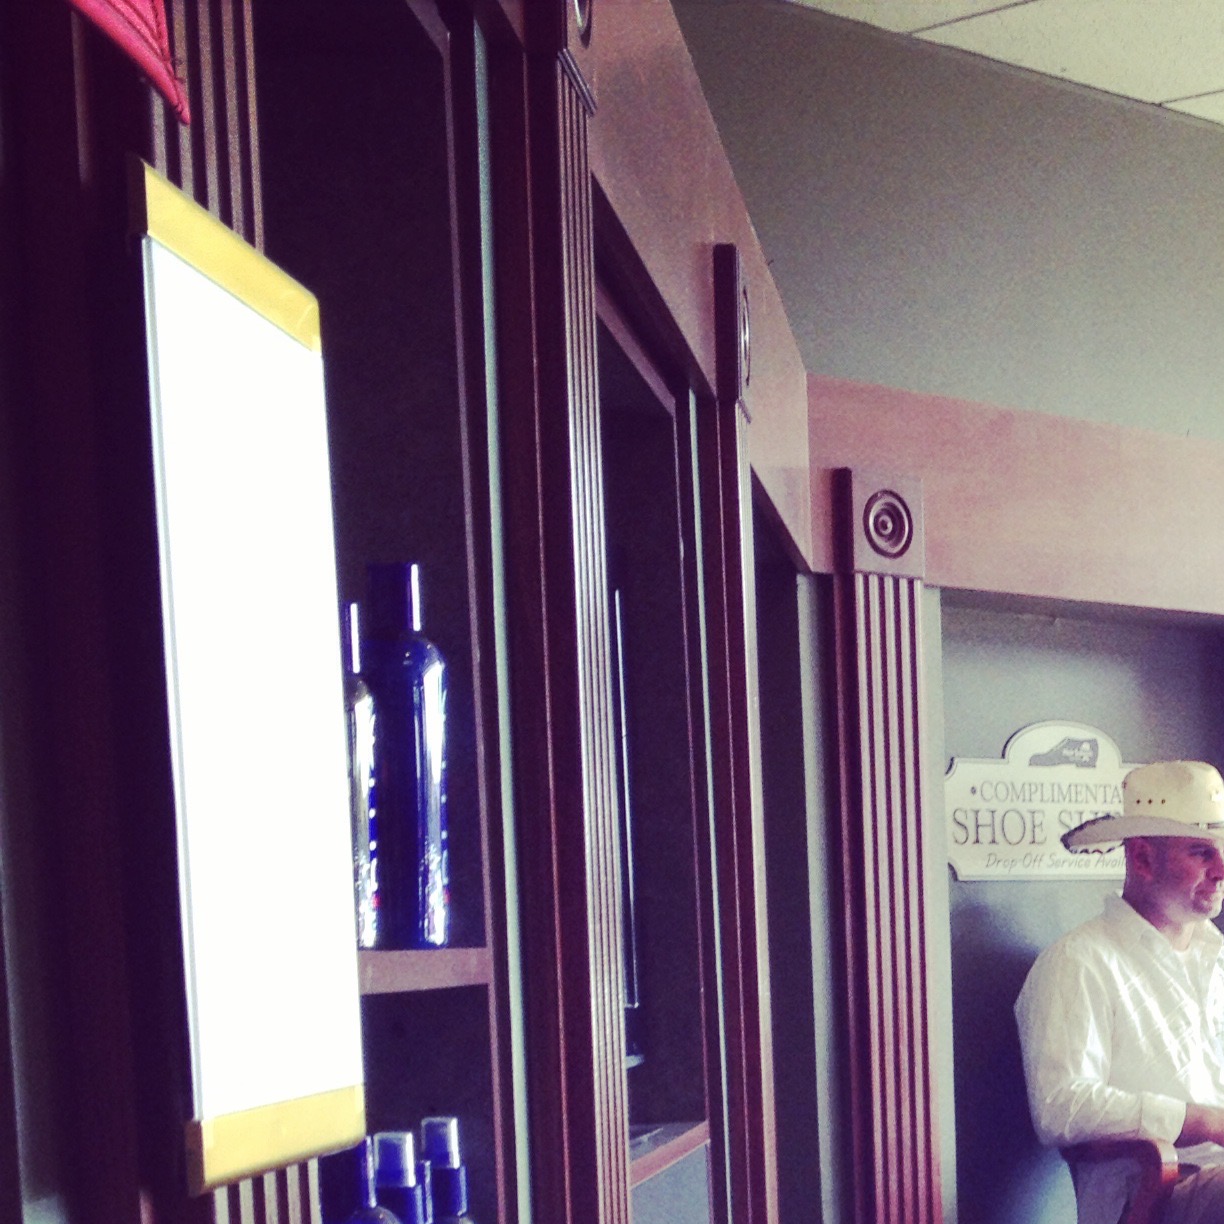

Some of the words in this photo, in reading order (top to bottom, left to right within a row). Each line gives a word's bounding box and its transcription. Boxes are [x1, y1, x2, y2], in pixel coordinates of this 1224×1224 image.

[980, 780, 1123, 804] COMPLIMENTA
[952, 808, 1047, 846] SHOE
[985, 852, 1018, 874] Drop
[1022, 852, 1045, 869] Off
[1047, 852, 1092, 868] Service
[1095, 853, 1126, 868] Avail
